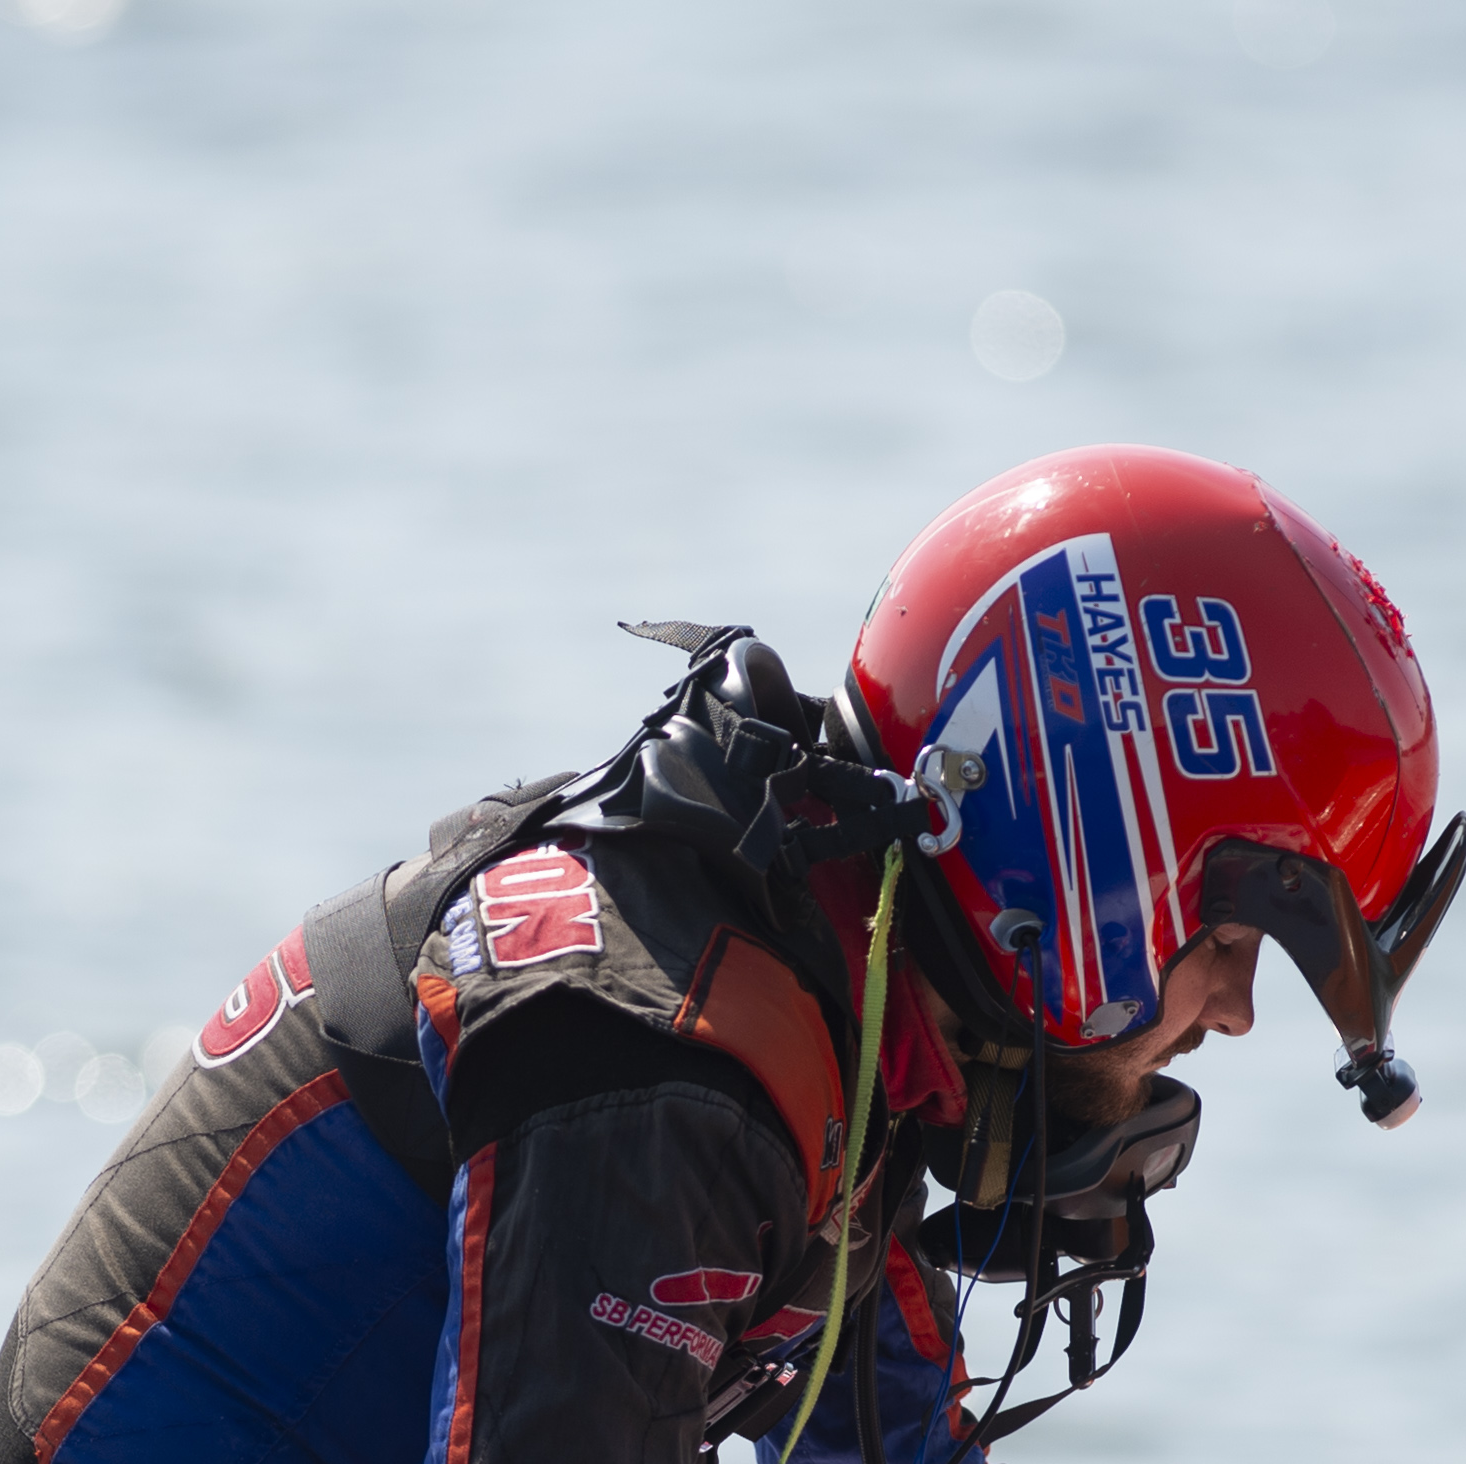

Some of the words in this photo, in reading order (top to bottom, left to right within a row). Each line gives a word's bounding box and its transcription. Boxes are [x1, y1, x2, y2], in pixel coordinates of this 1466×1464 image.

[1036, 607, 1085, 725] TKO
[1075, 572, 1147, 733] HAYES
[1138, 593, 1278, 781] 35
[590, 1293, 632, 1327] SB
[626, 1304, 725, 1372] PERFORMA
